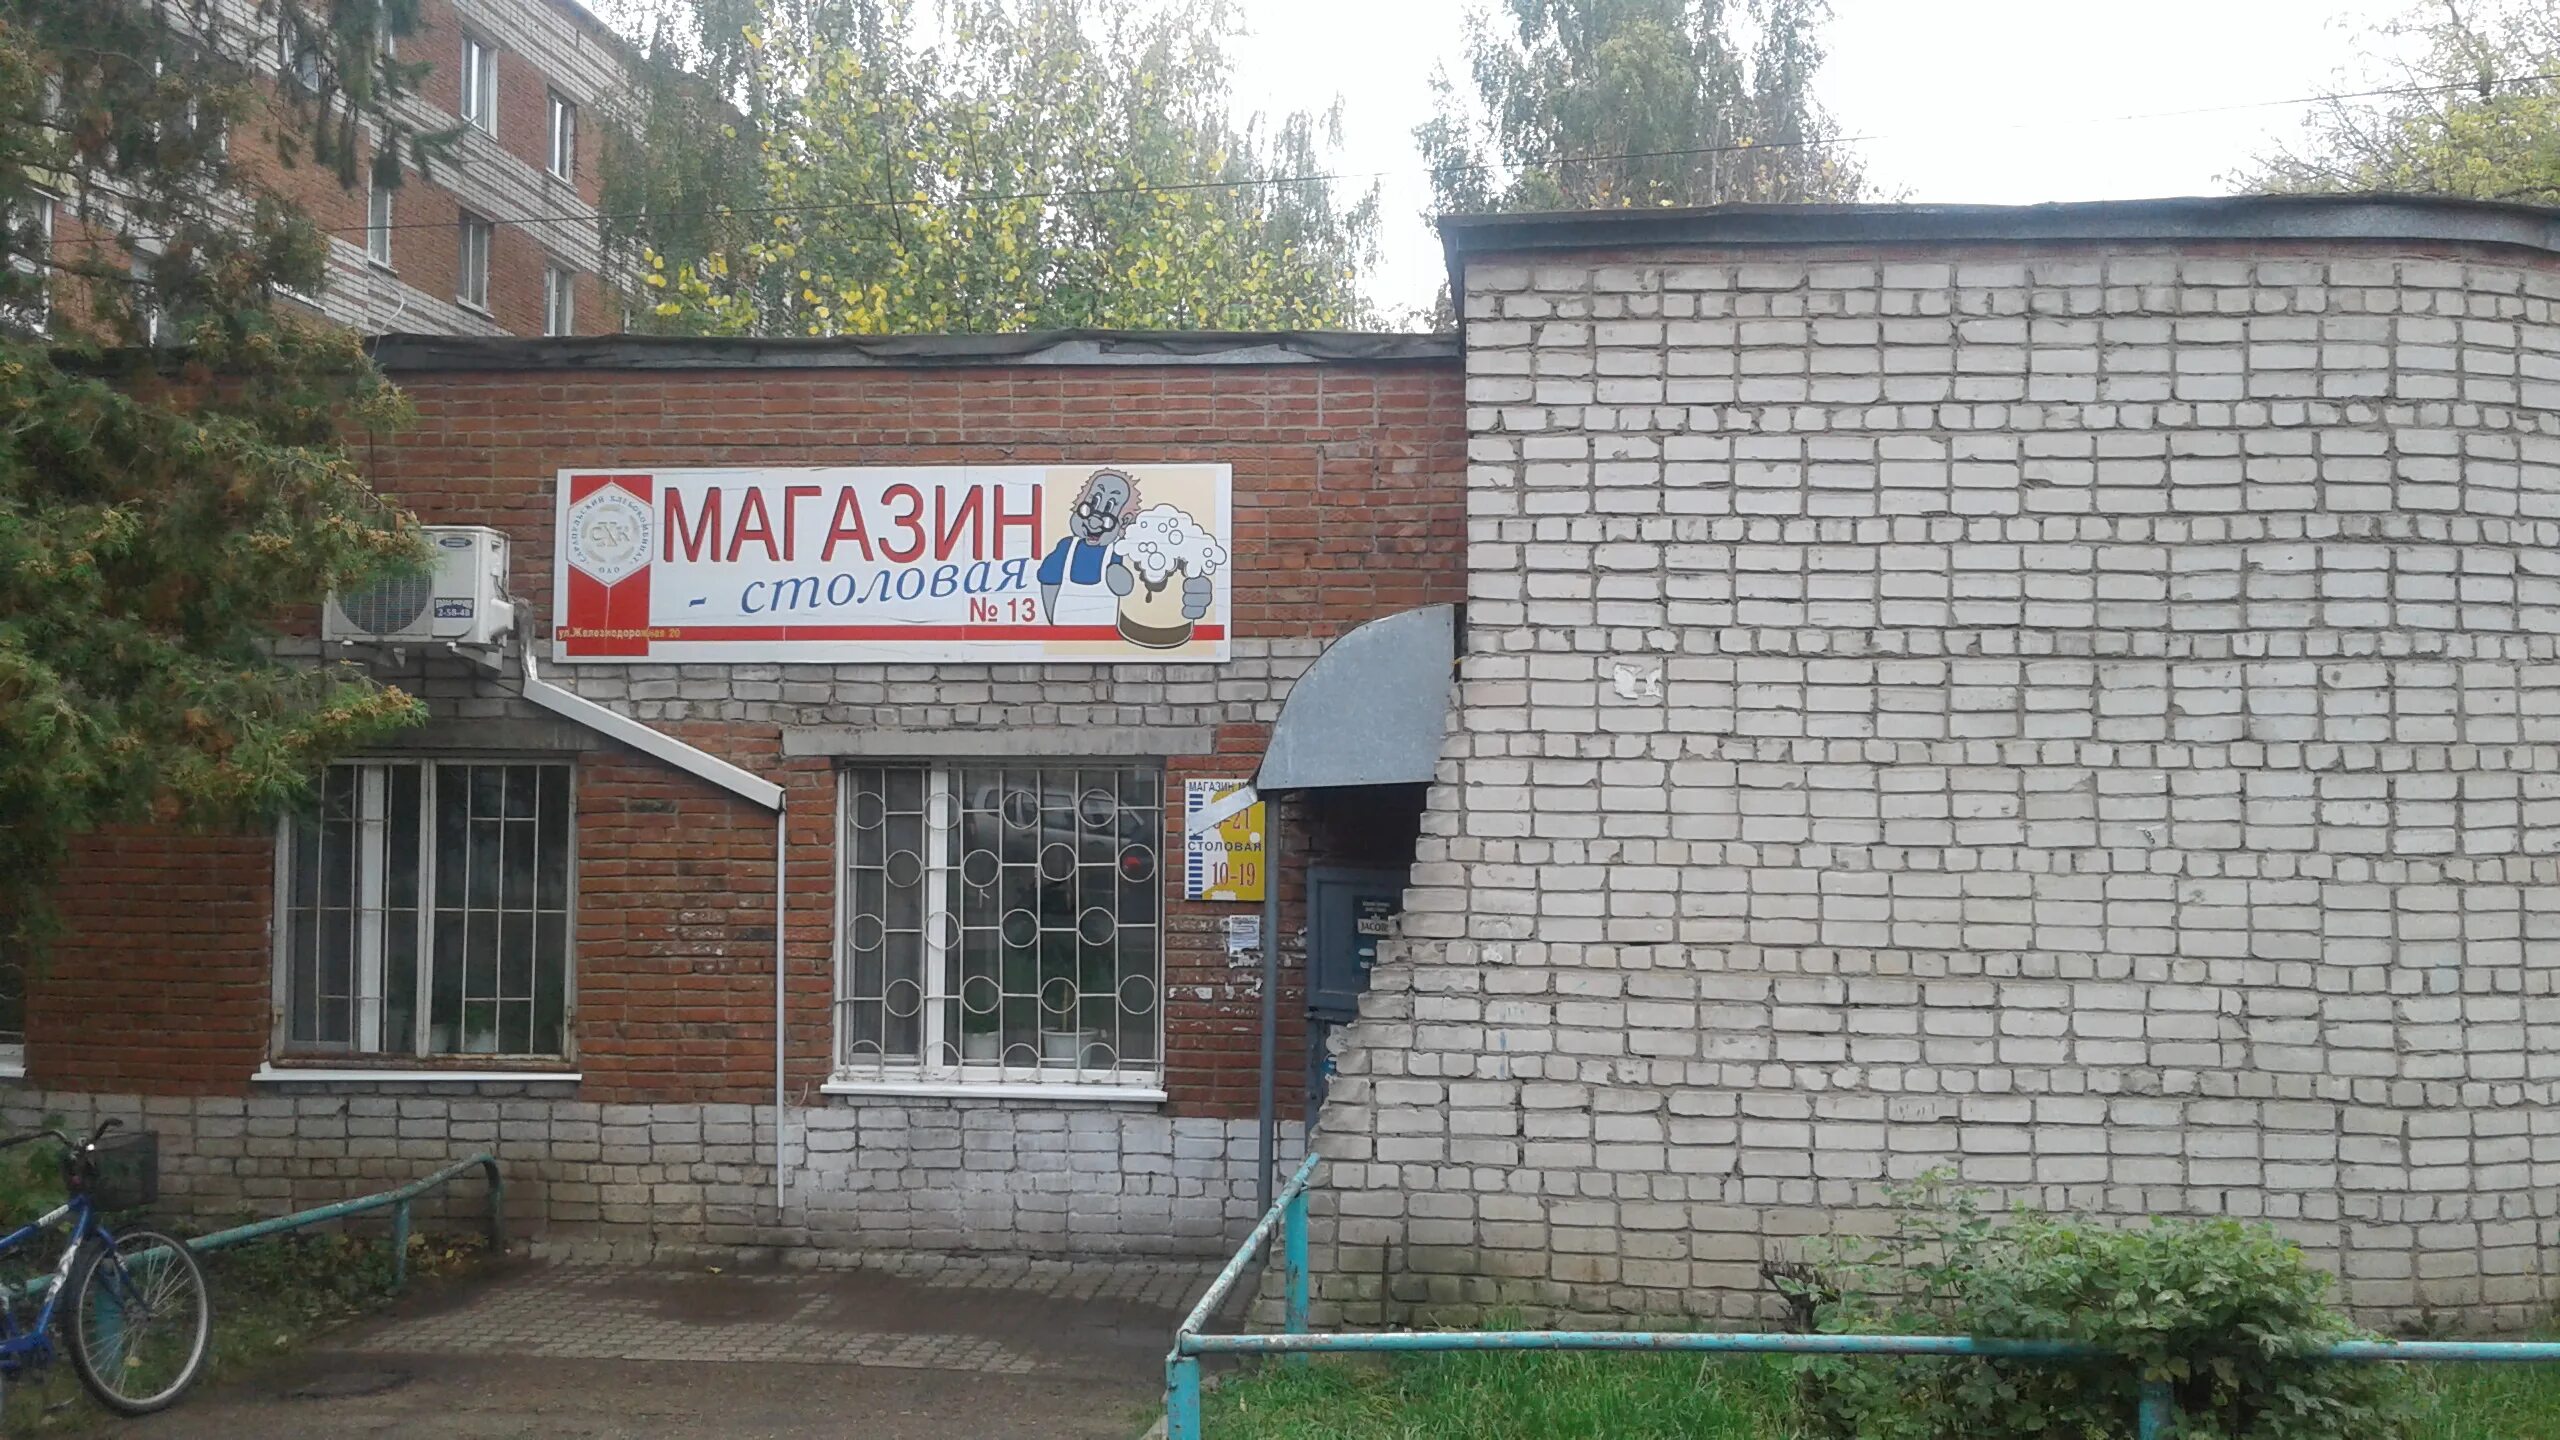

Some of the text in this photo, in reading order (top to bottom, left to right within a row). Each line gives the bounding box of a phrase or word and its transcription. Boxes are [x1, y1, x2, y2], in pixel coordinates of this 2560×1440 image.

[663, 483, 1042, 563] МАГАЗИН
[741, 557, 1029, 613] столовая
[969, 597, 1036, 622] № 13
[1188, 781, 1233, 792] МАГАЗИН
[1187, 840, 1262, 852] СТОЛОВАЯ
[1212, 861, 1256, 887] 10-19
